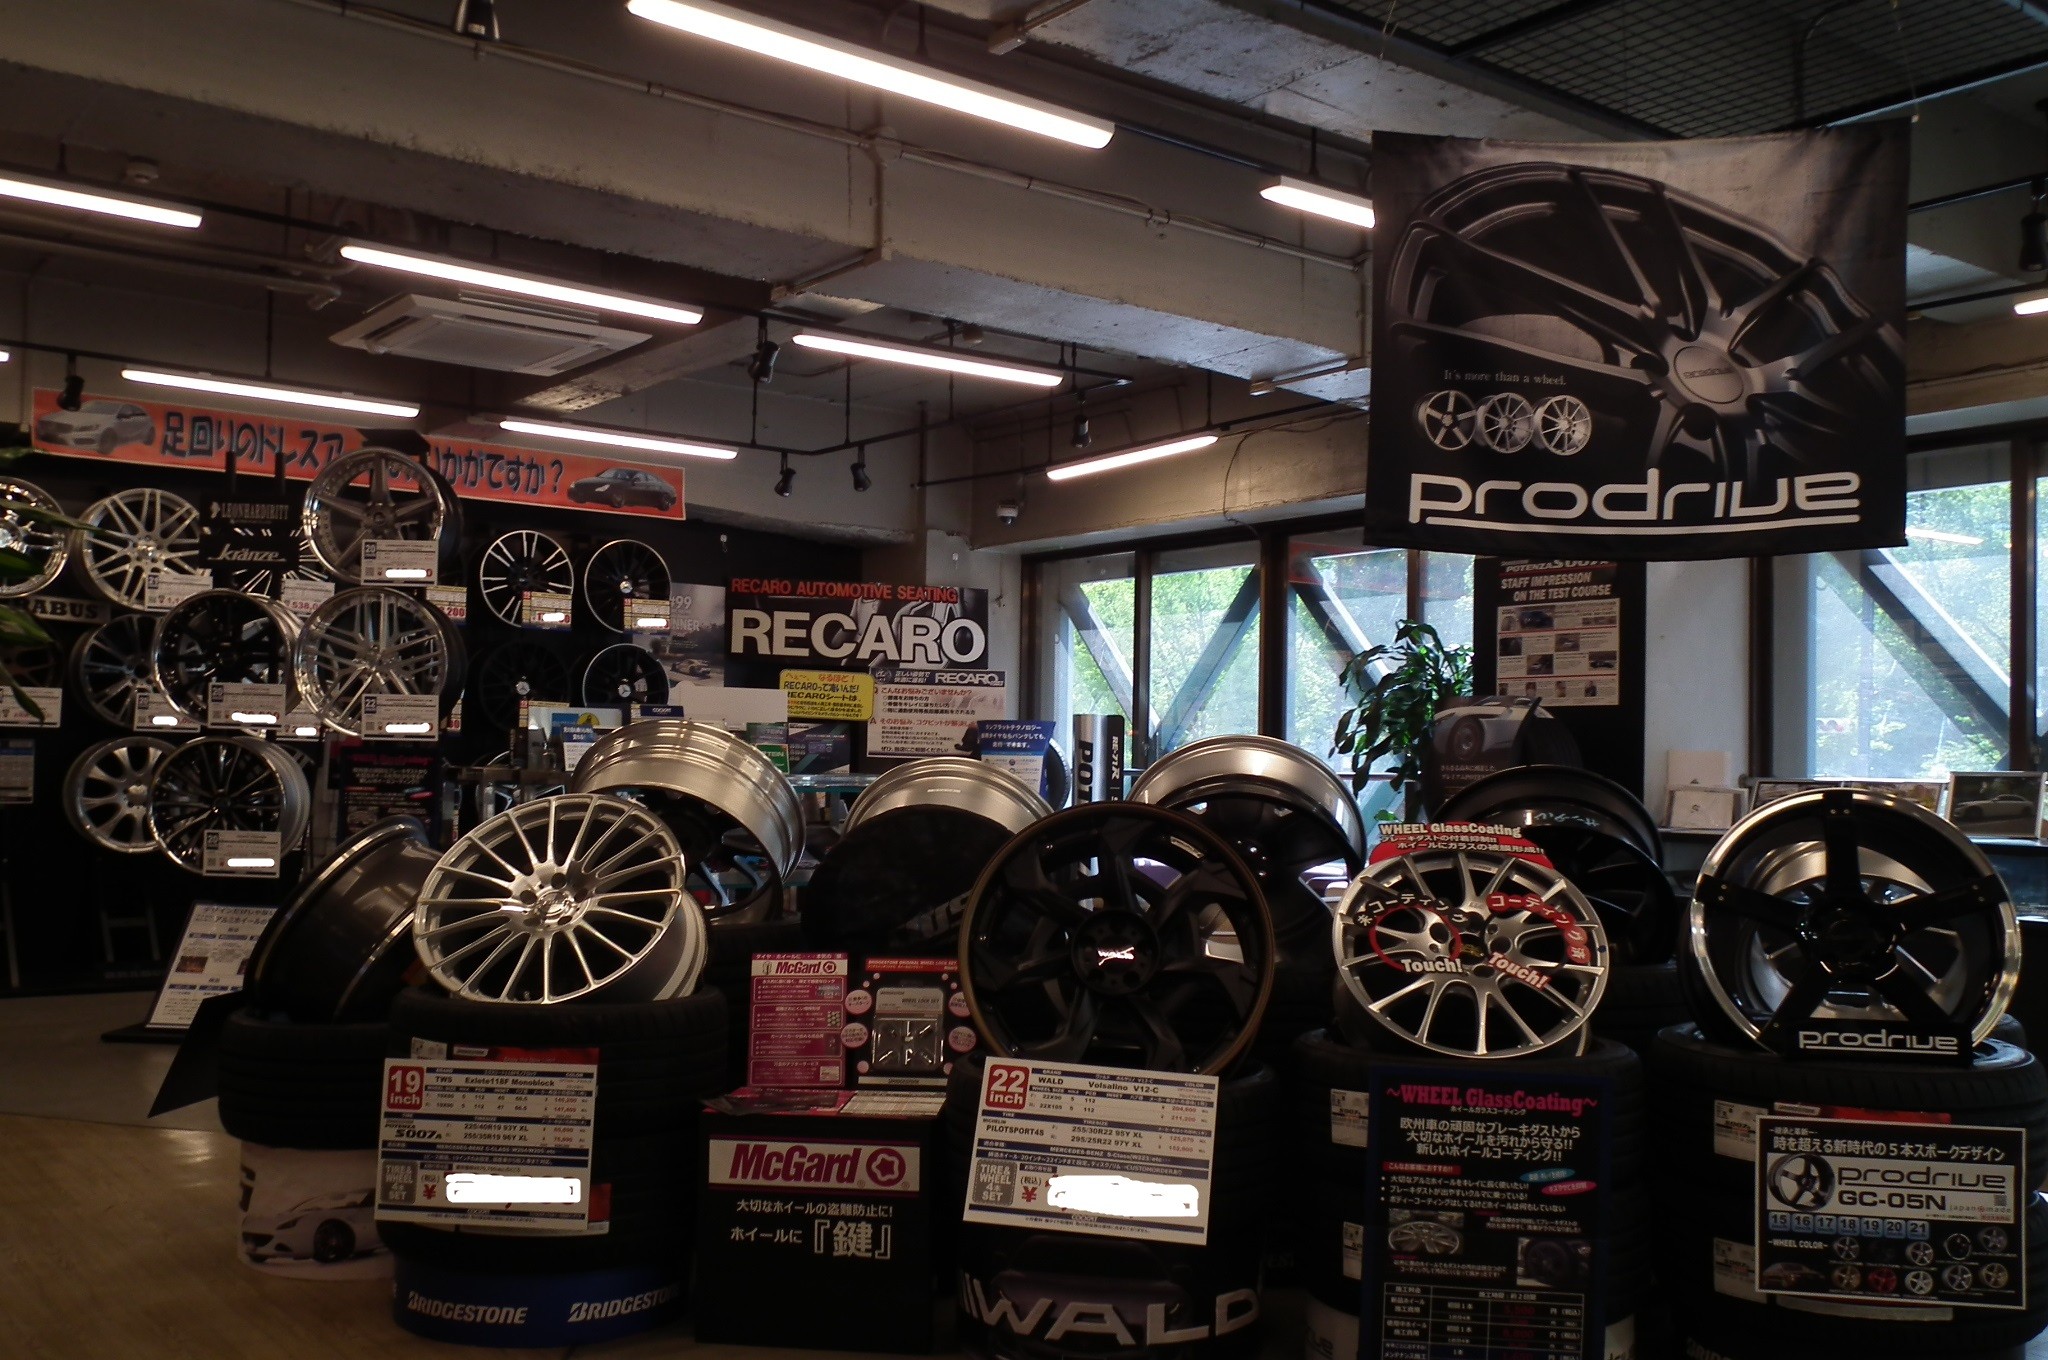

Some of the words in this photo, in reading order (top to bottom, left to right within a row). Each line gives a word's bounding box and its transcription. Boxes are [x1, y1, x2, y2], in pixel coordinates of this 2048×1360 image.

[1465, 373, 1489, 382] more
[1495, 371, 1519, 383] than
[1523, 375, 1530, 383] a
[1409, 467, 1861, 525] prodrive
[1501, 576, 1530, 590] STAFF
[1531, 571, 1592, 587] IMPRESSION
[731, 578, 791, 596] RECARO
[797, 580, 892, 600] AUTOMOTIVE
[897, 584, 958, 604] SEATING
[1513, 590, 1528, 602] ON
[1529, 588, 1547, 601] THE
[1548, 587, 1571, 599] TEST
[1572, 583, 1612, 598] COURSE
[730, 608, 986, 664] RECARO
[934, 671, 1000, 685] RECARO
[1380, 823, 1429, 836] WHEEL
[1431, 822, 1522, 838] GlassCoating
[775, 960, 821, 974] McGard
[1401, 957, 1463, 973] Touch!
[1488, 951, 1550, 989] Touch!
[1799, 1028, 1959, 1051] prodrive
[389, 1069, 422, 1093] 19
[990, 1068, 1025, 1094] 22
[1038, 1076, 1064, 1085] WALD
[1088, 1080, 1128, 1091] Volsalino
[1133, 1085, 1159, 1094] V12-C
[389, 1092, 421, 1106] inch
[989, 1091, 1024, 1105] inch
[1113, 1138, 1130, 1147] 97Y
[1131, 1140, 1142, 1148] XL
[1132, 1131, 1143, 1139] XL
[729, 1143, 862, 1184] McGard
[980, 1164, 1010, 1175] TIRE&
[979, 1172, 1012, 1184] WHEEL
[1838, 1166, 2006, 1188] prodrive
[423, 1184, 437, 1200] ¥
[982, 1191, 1003, 1202] SET
[1021, 1186, 1037, 1202] ¥
[1838, 1189, 1946, 1211] GC-05N
[736, 1198, 893, 1217] 大切なホイールの盗難防止に!
[1771, 1214, 1787, 1225] 15
[1794, 1216, 1811, 1226] 16
[1817, 1217, 1833, 1228] 17
[1840, 1219, 1856, 1230] 18
[1863, 1220, 1879, 1231] 19
[1886, 1221, 1901, 1232] 20
[1909, 1222, 1926, 1233] 21
[730, 1226, 803, 1244] ホイールに
[814, 1218, 892, 1260] 『鍵』
[407, 1289, 529, 1325] BRIDGESTONE
[965, 1273, 1260, 1347] WALD
